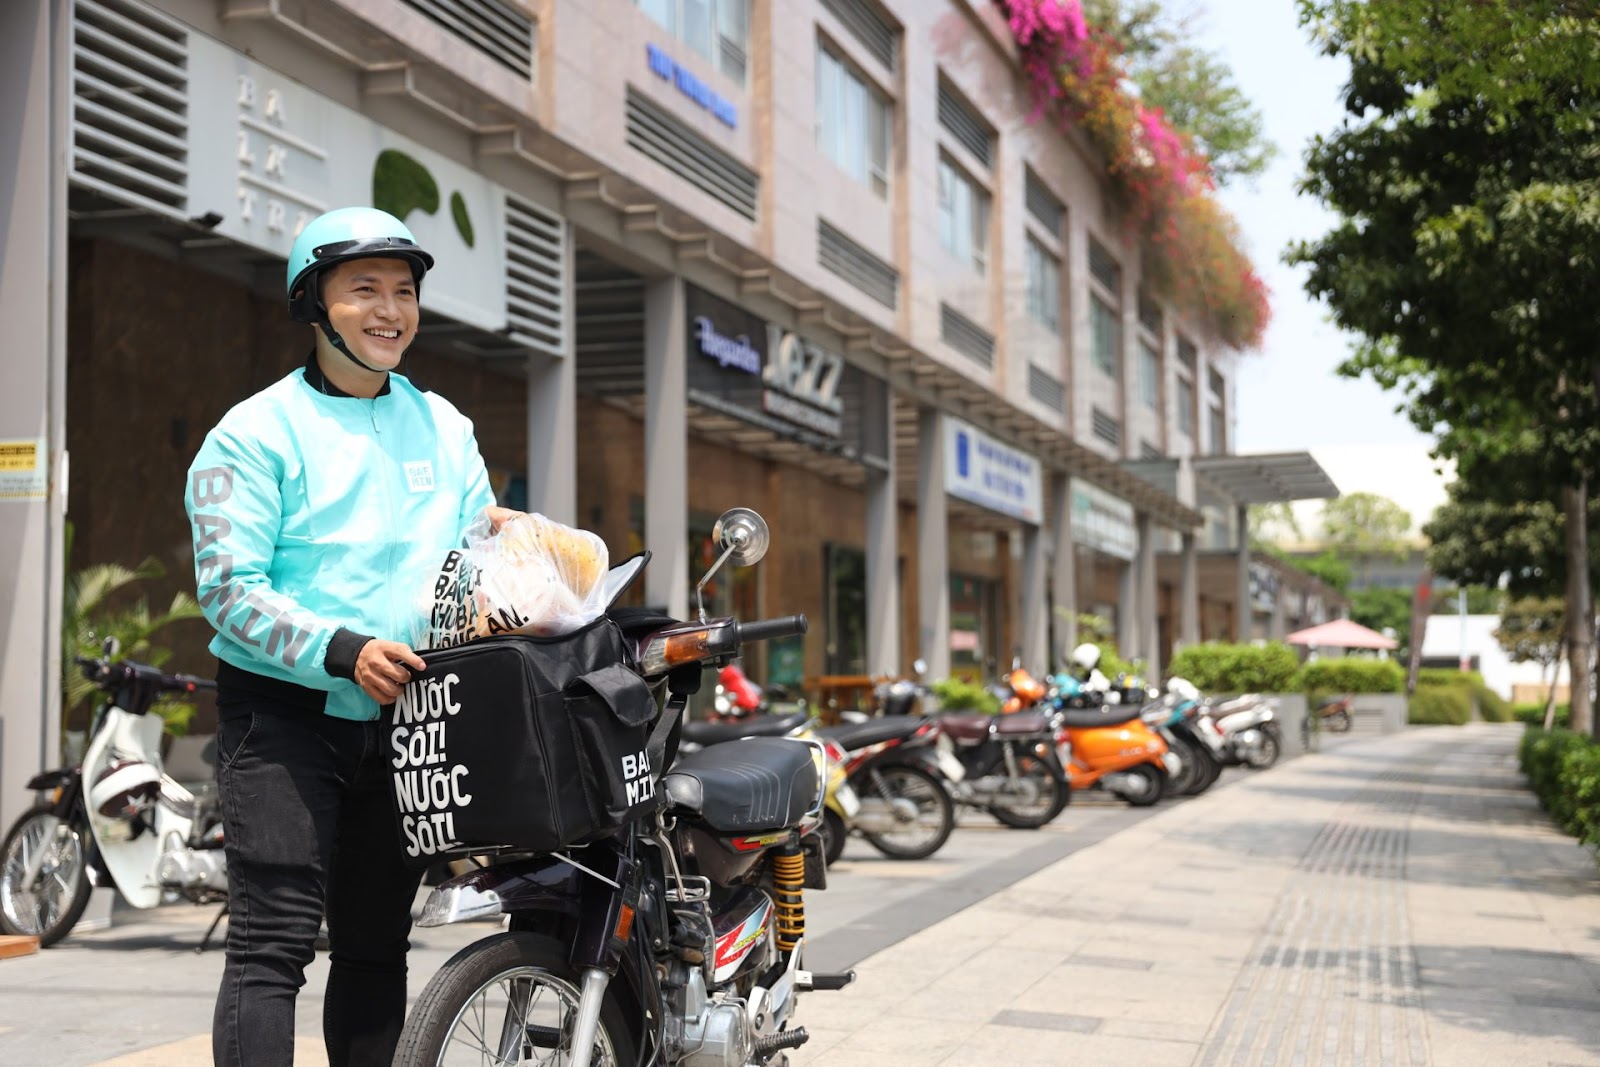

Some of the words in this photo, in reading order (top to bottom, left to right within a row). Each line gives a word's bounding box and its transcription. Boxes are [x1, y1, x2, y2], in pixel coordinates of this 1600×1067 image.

[411, 476, 432, 488] MIN
[192, 466, 316, 668] BAEMIN
[392, 672, 462, 725] NƯỚC
[391, 720, 447, 769] SÔI!
[393, 764, 473, 813] NƯỚC
[402, 811, 464, 857] SÔI!
